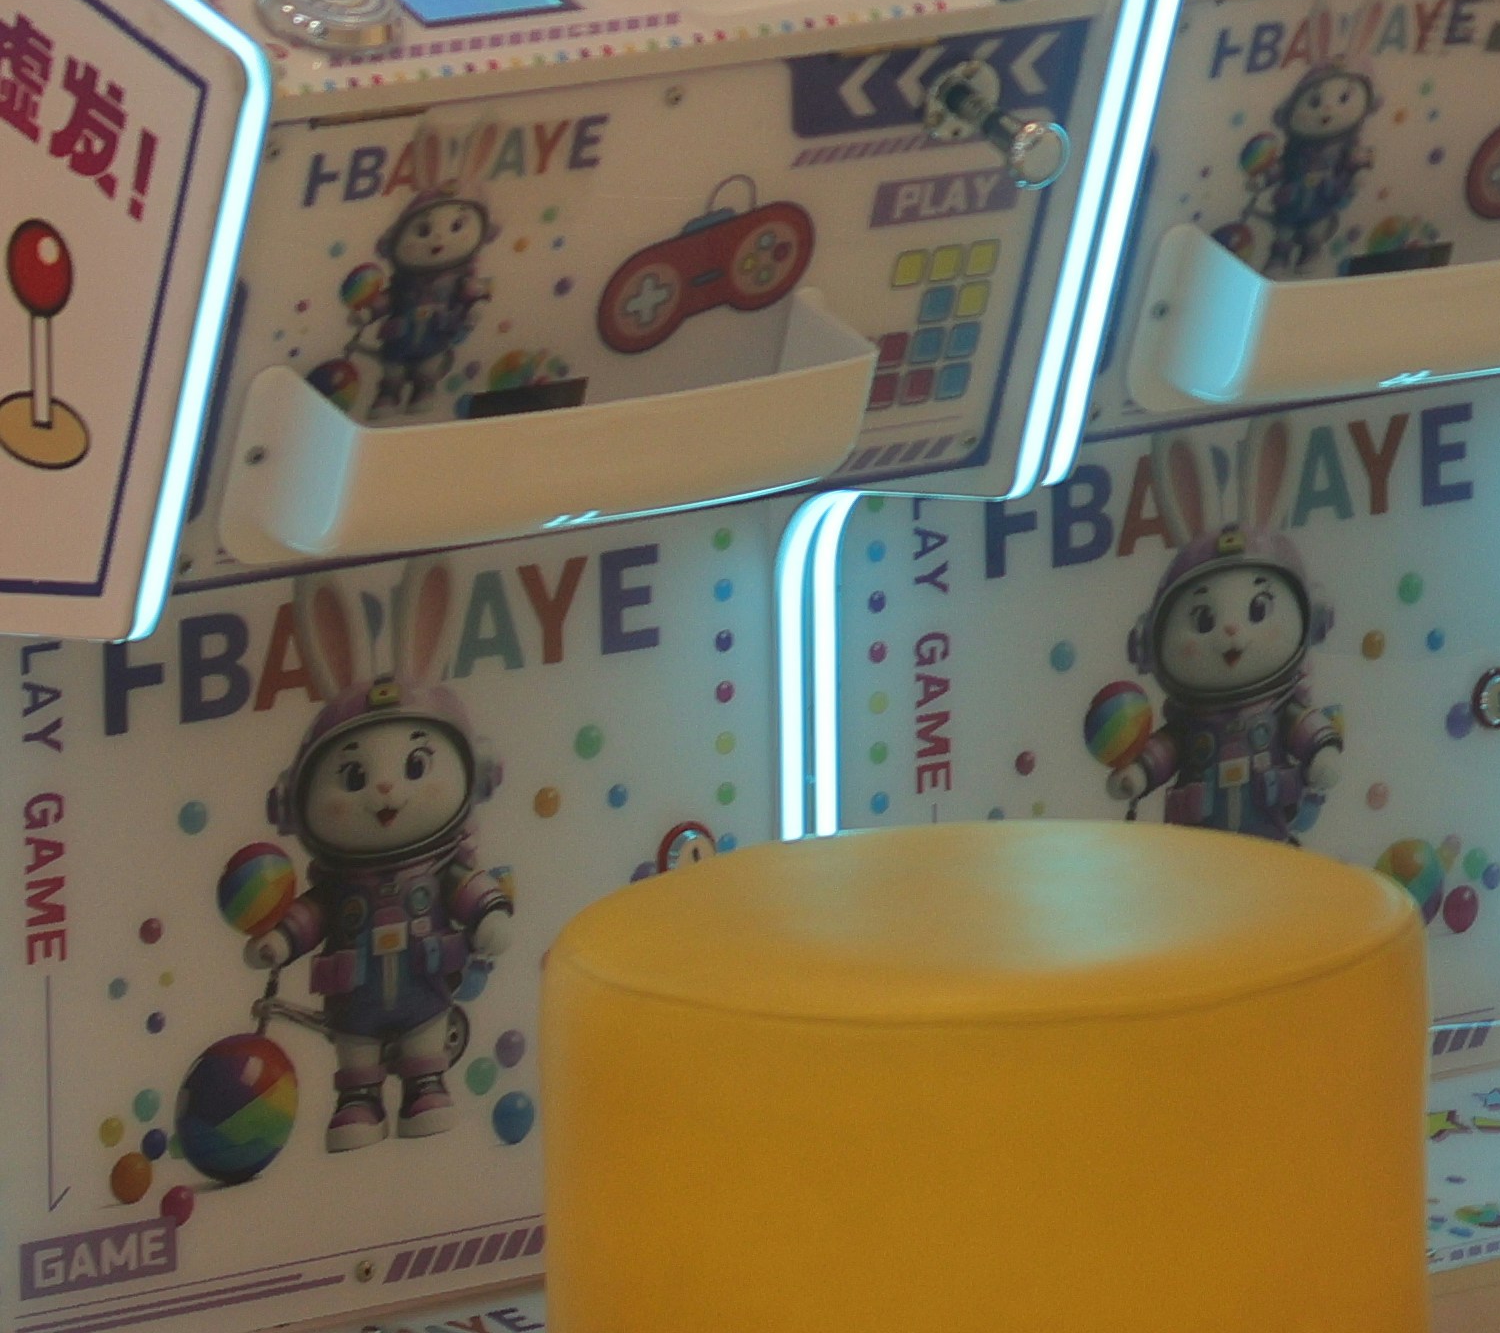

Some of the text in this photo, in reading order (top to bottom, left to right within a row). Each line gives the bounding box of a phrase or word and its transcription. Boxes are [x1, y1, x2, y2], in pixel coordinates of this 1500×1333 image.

[889, 168, 1000, 223] PLAY
[910, 497, 952, 795] LAY GAME
[18, 641, 68, 967] LAY GAME
[32, 1226, 169, 1288] GAME
